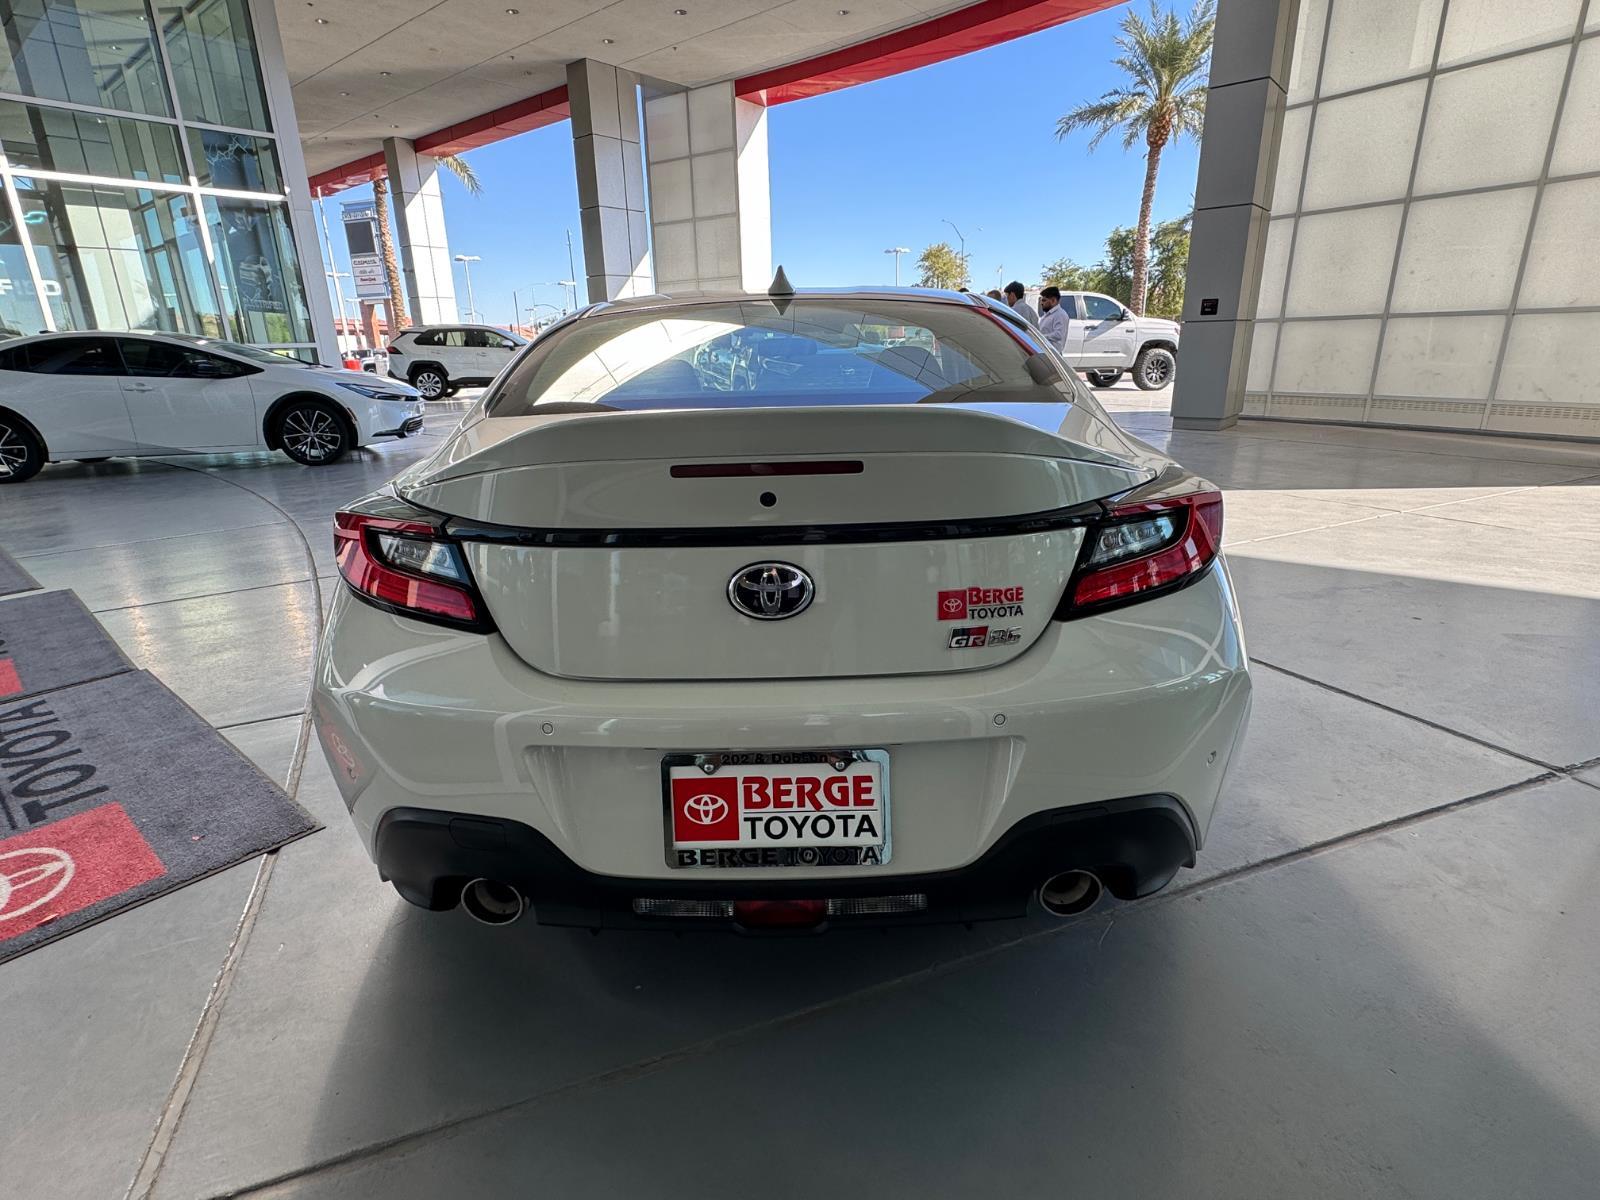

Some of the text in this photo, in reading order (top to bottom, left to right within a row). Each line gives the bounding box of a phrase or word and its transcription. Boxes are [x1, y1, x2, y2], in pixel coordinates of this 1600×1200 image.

[968, 586, 1024, 605] BERGE
[969, 605, 1024, 619] TOYOTA
[950, 634, 986, 648] GR
[742, 775, 875, 811] BERGE
[744, 814, 878, 840] TOYOTA
[678, 849, 778, 866] BERGE
